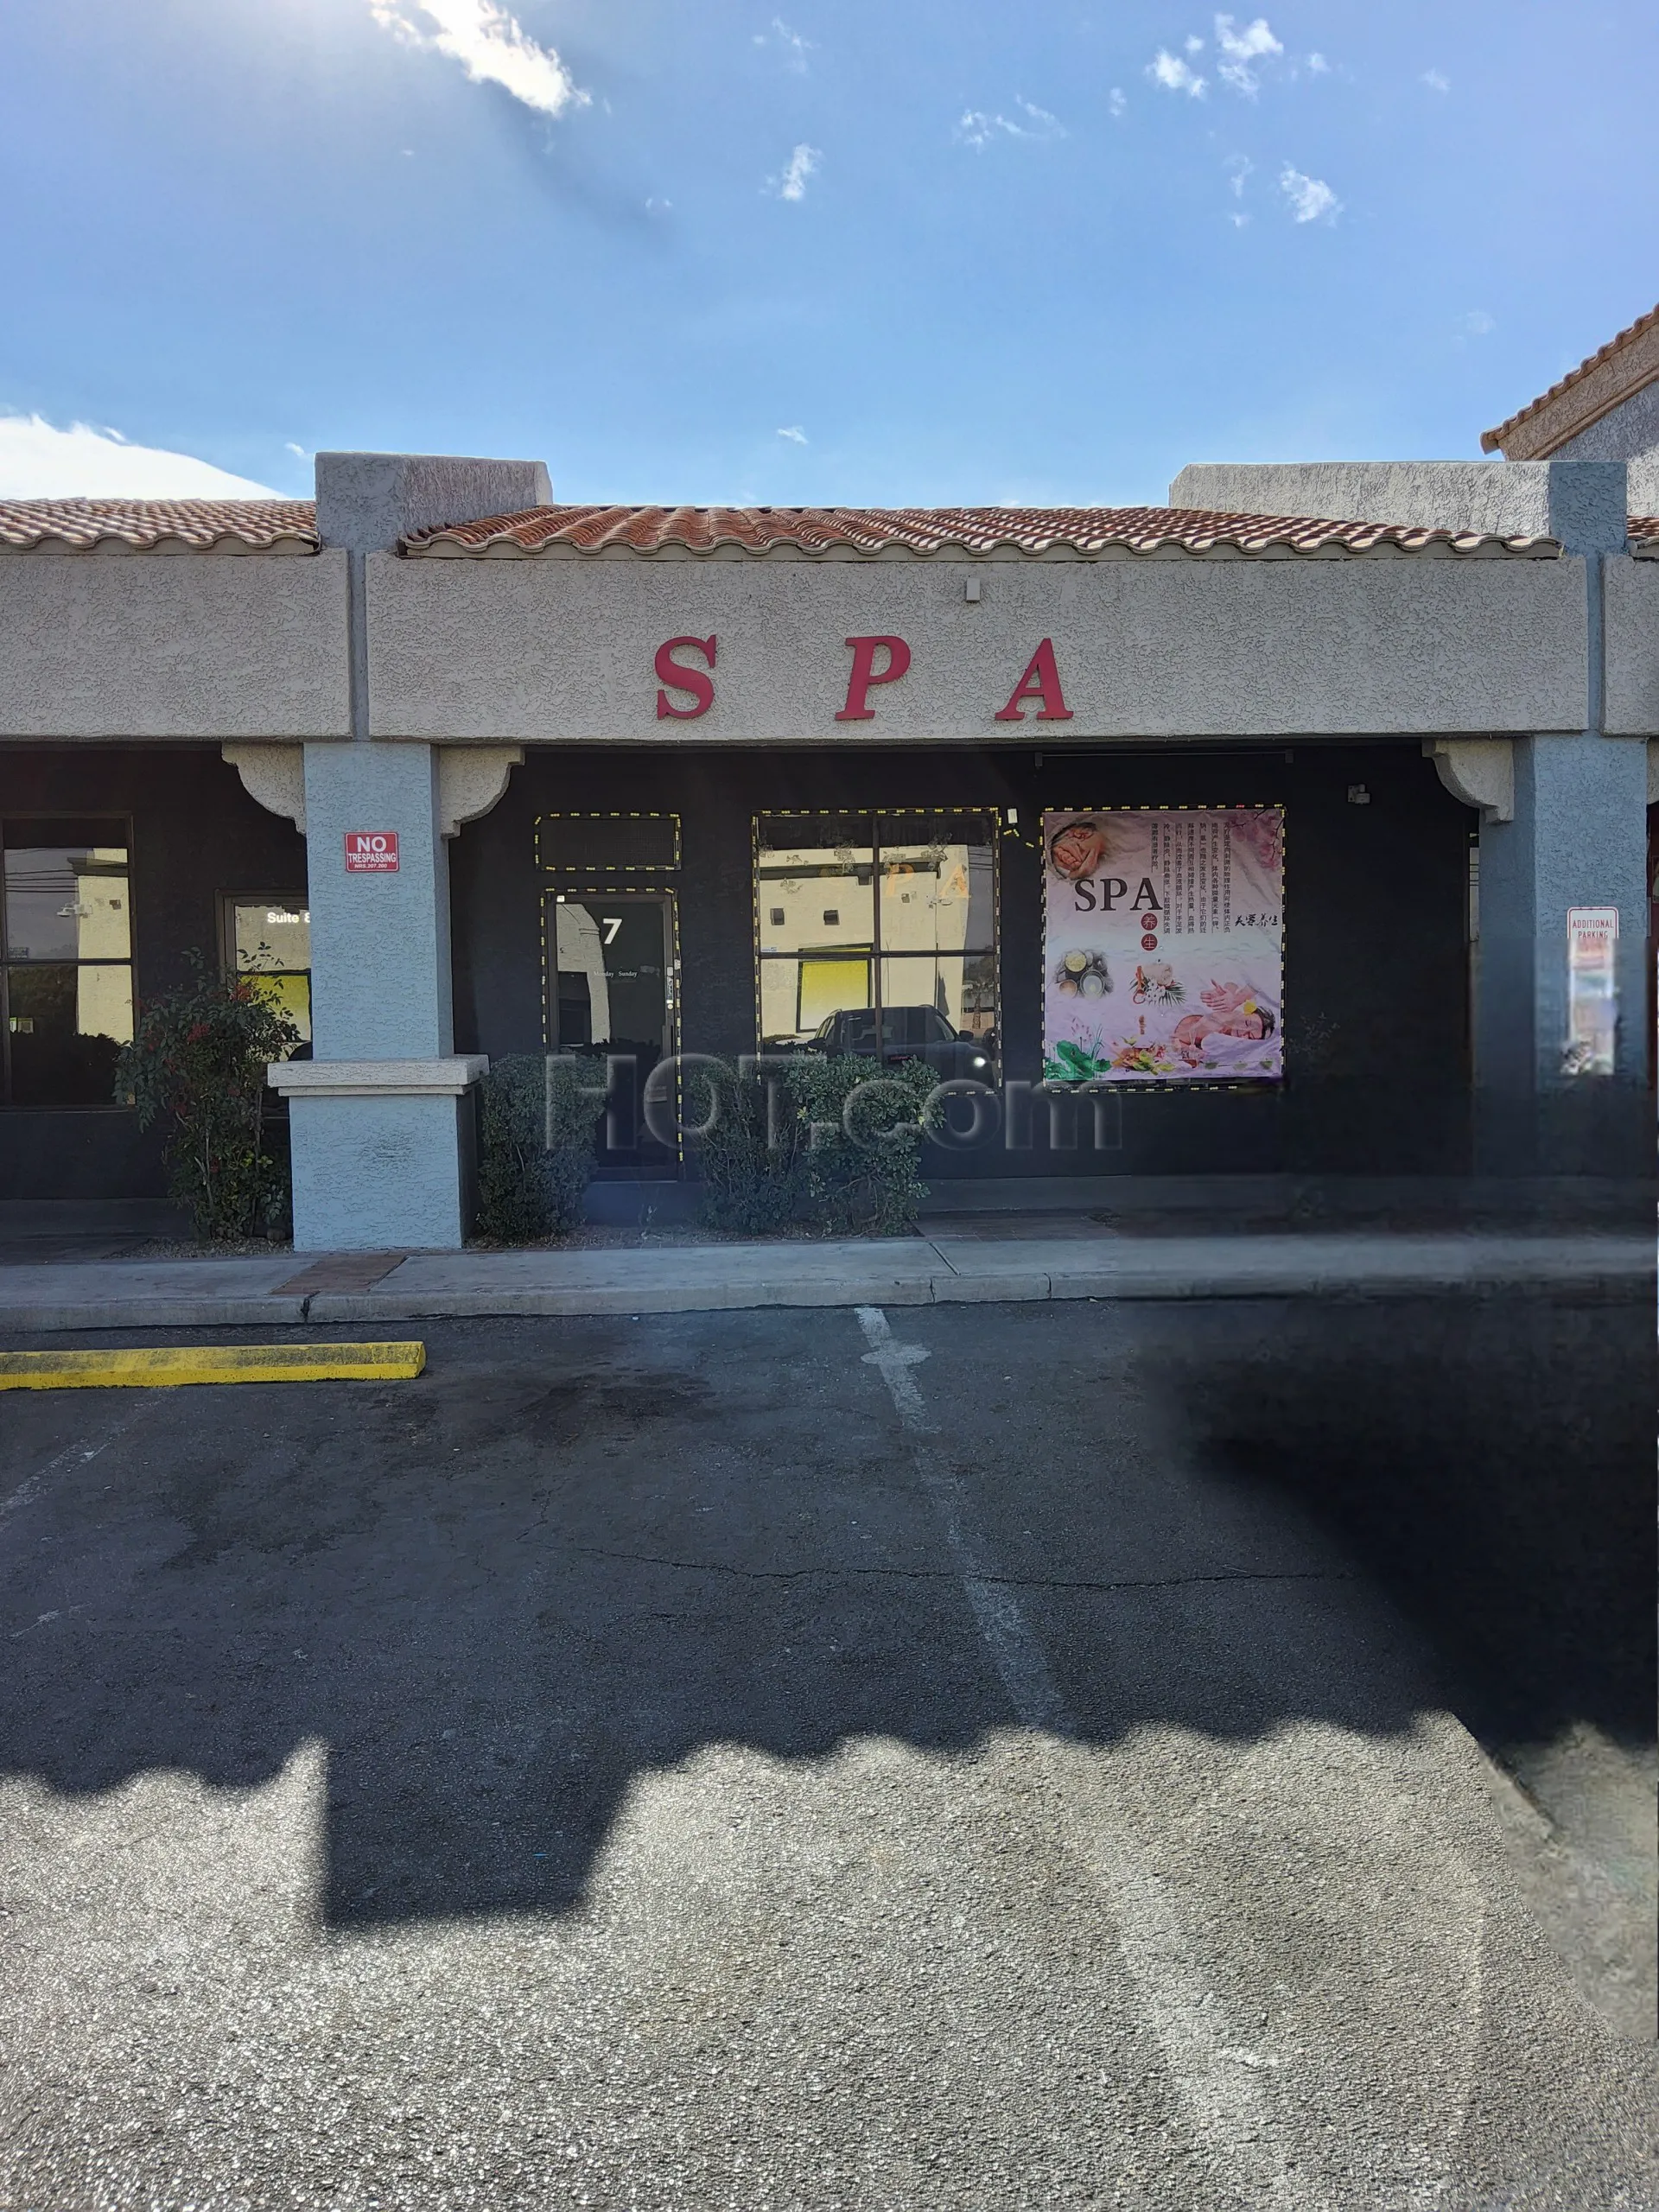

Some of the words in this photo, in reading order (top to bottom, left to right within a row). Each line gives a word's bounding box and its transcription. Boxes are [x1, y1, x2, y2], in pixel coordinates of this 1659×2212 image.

[357, 836, 387, 852] NO
[348, 852, 397, 863] TRESPASSING
[1074, 877, 1163, 912] SPA
[267, 912, 300, 924] Suite
[1572, 919, 1614, 929] ADDITIONAL
[602, 918, 623, 944] 7
[1578, 931, 1608, 939] PARKING
